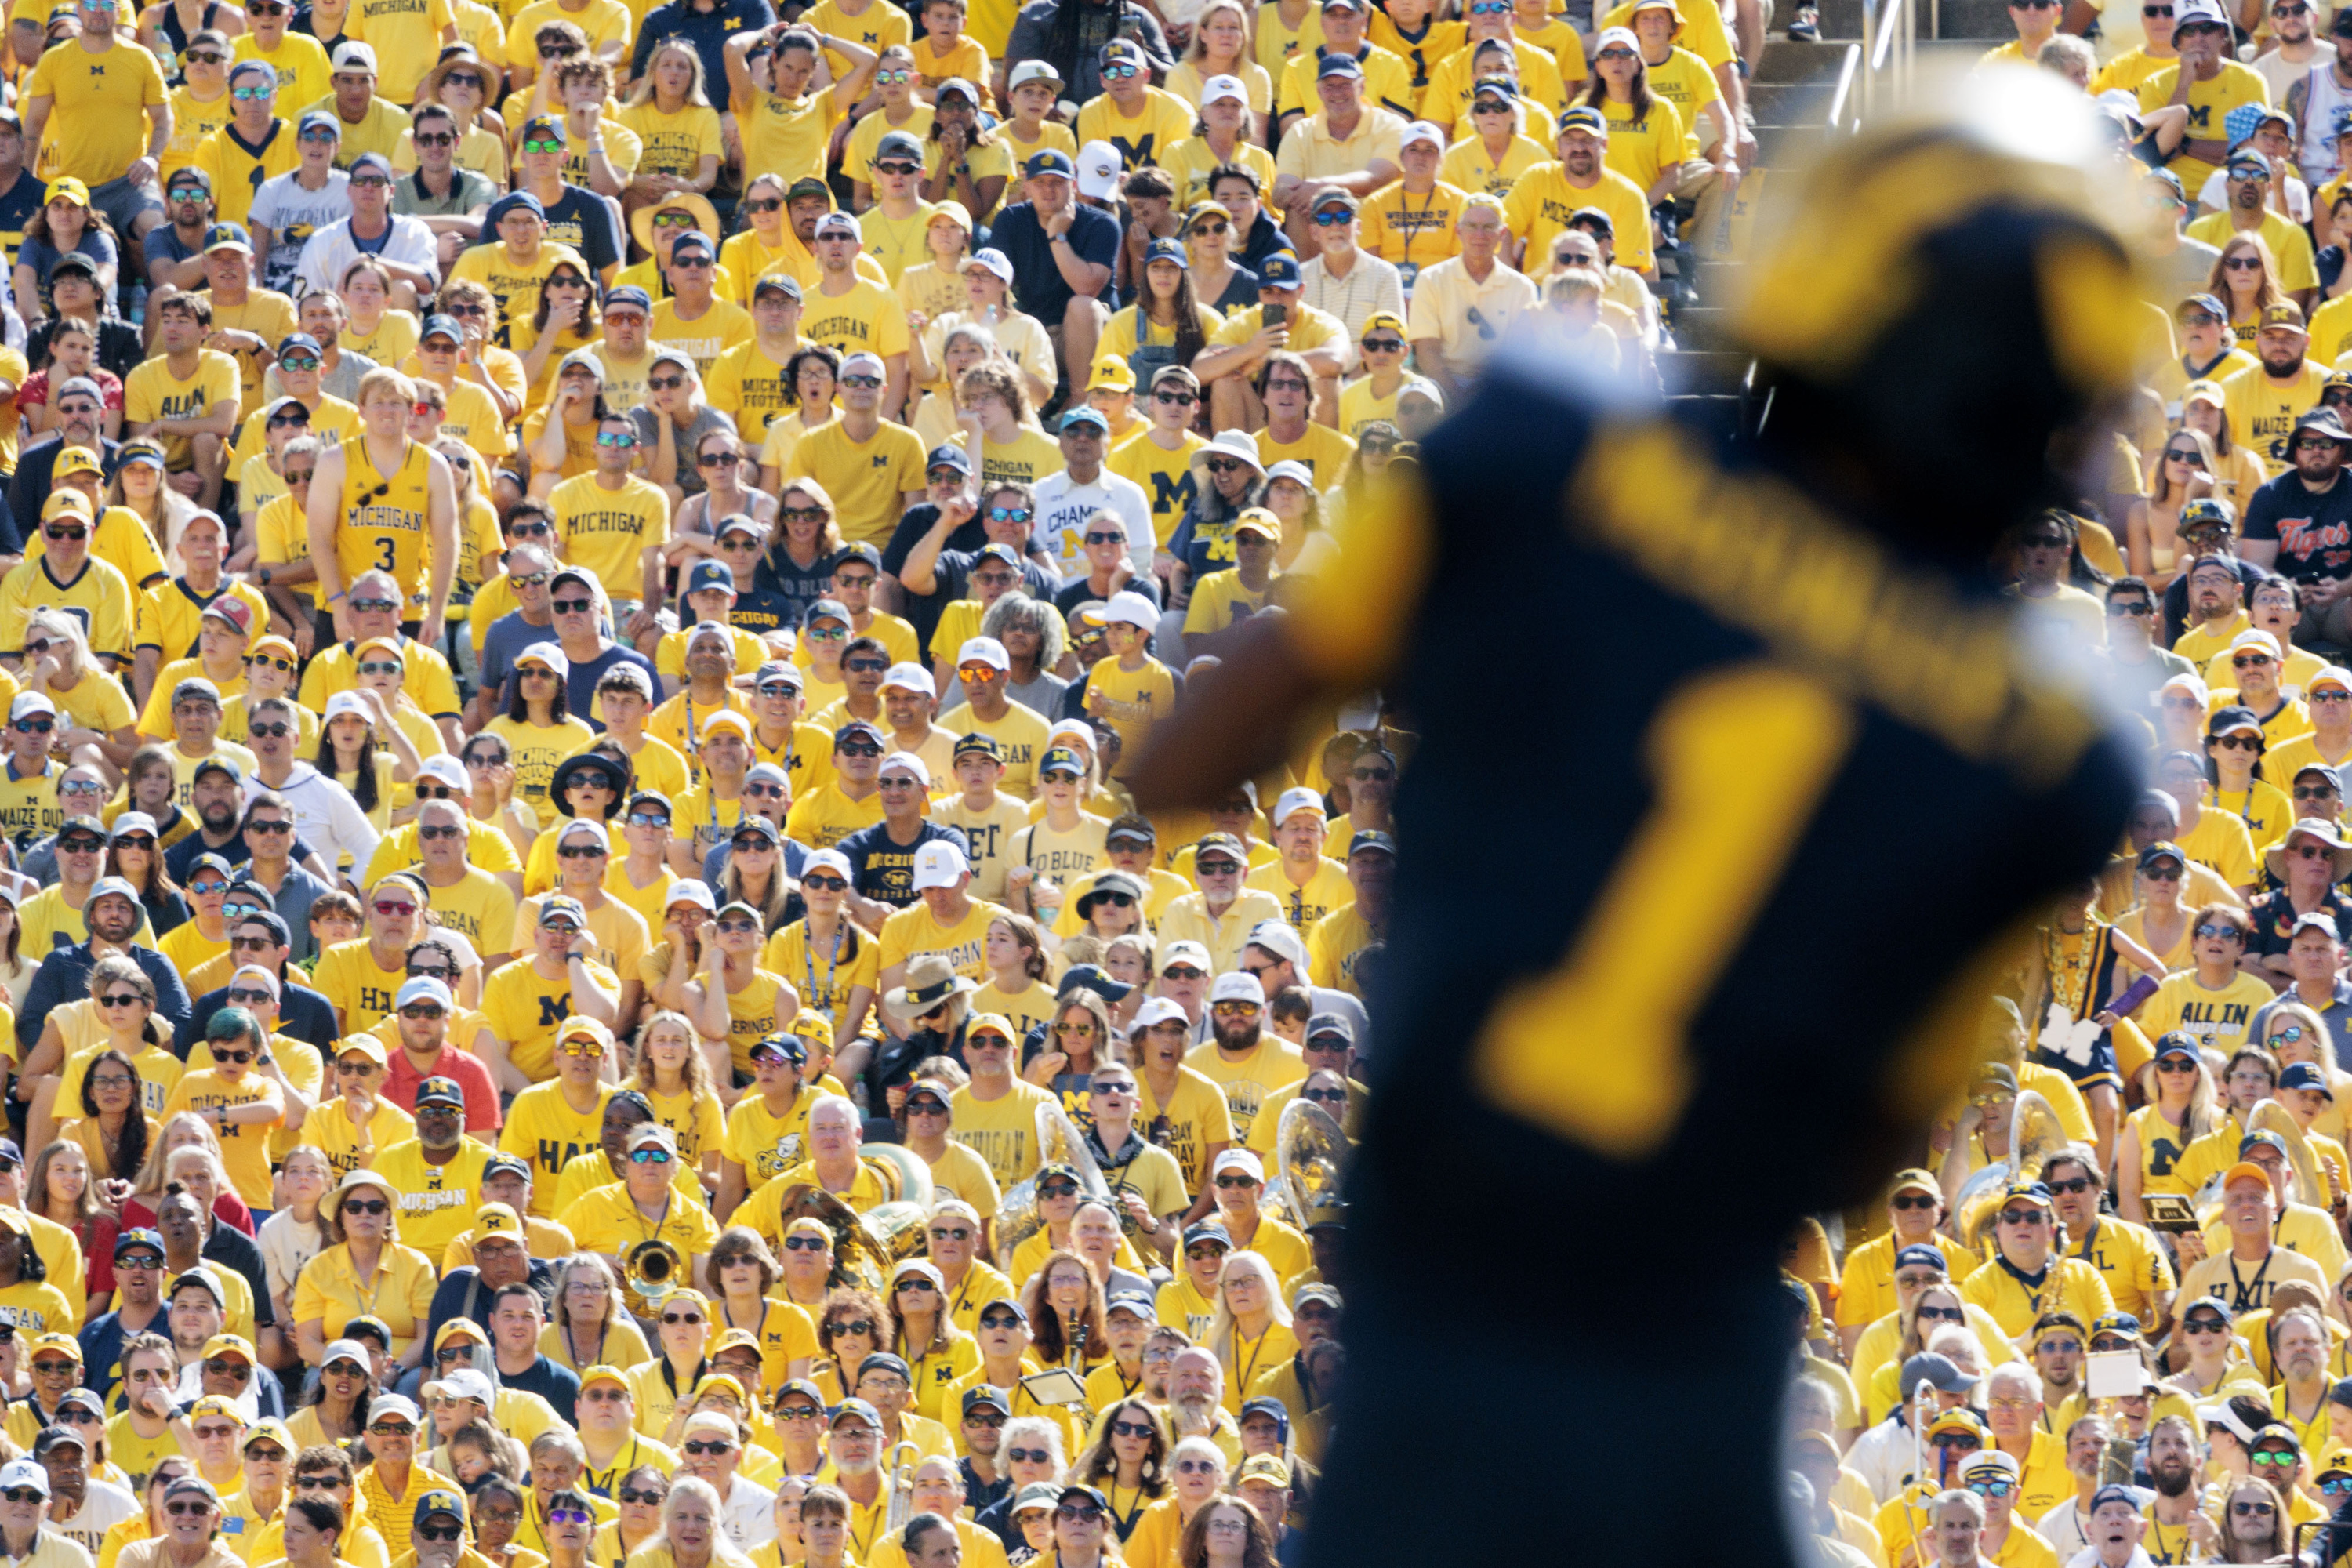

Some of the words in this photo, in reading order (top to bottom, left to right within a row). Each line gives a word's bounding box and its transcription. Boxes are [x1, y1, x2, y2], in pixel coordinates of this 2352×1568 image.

[364, 1, 427, 18] MICHIGAN
[724, 17, 741, 30] M
[864, 32, 877, 42] M
[1108, 45, 1123, 56] M
[91, 66, 104, 74] M
[1410, 49, 1425, 85] 1
[2187, 105, 2211, 126] M
[1110, 134, 1153, 172] M
[217, 227, 234, 240] M
[2271, 309, 2288, 320] M
[805, 317, 869, 341] MICHIGAN
[73, 455, 90, 466] M
[873, 456, 887, 466] M
[1150, 471, 1197, 514] M
[61, 497, 76, 506] M
[2186, 505, 2204, 518] M
[348, 508, 423, 531] MICHIGAN
[568, 513, 644, 535] MICHIGAN
[2277, 519, 2350, 560] Tigers
[374, 538, 395, 572] 3
[1207, 539, 1236, 561] M
[1136, 691, 1150, 702] M
[1052, 750, 1070, 760] M
[743, 816, 762, 828] M
[2247, 820, 2263, 830] M
[925, 855, 937, 864] M
[1051, 851, 1094, 873] BLUE
[1052, 876, 1065, 885] M
[538, 993, 572, 1025] M
[2181, 1002, 2215, 1022] ALL
[2223, 1004, 2249, 1026] IN
[429, 1080, 448, 1092] M
[1063, 1091, 1090, 1111] M
[221, 1124, 239, 1137] M
[2151, 1139, 2186, 1176] M
[428, 1181, 441, 1189] M
[486, 1219, 500, 1228] M
[131, 1229, 147, 1241] M
[963, 1300, 973, 1310] M
[768, 1333, 781, 1341] M
[936, 1367, 951, 1380] M
[975, 1388, 993, 1398] M
[2332, 1456, 2346, 1466] M
[16, 1467, 32, 1476] M
[429, 1494, 452, 1508] M
